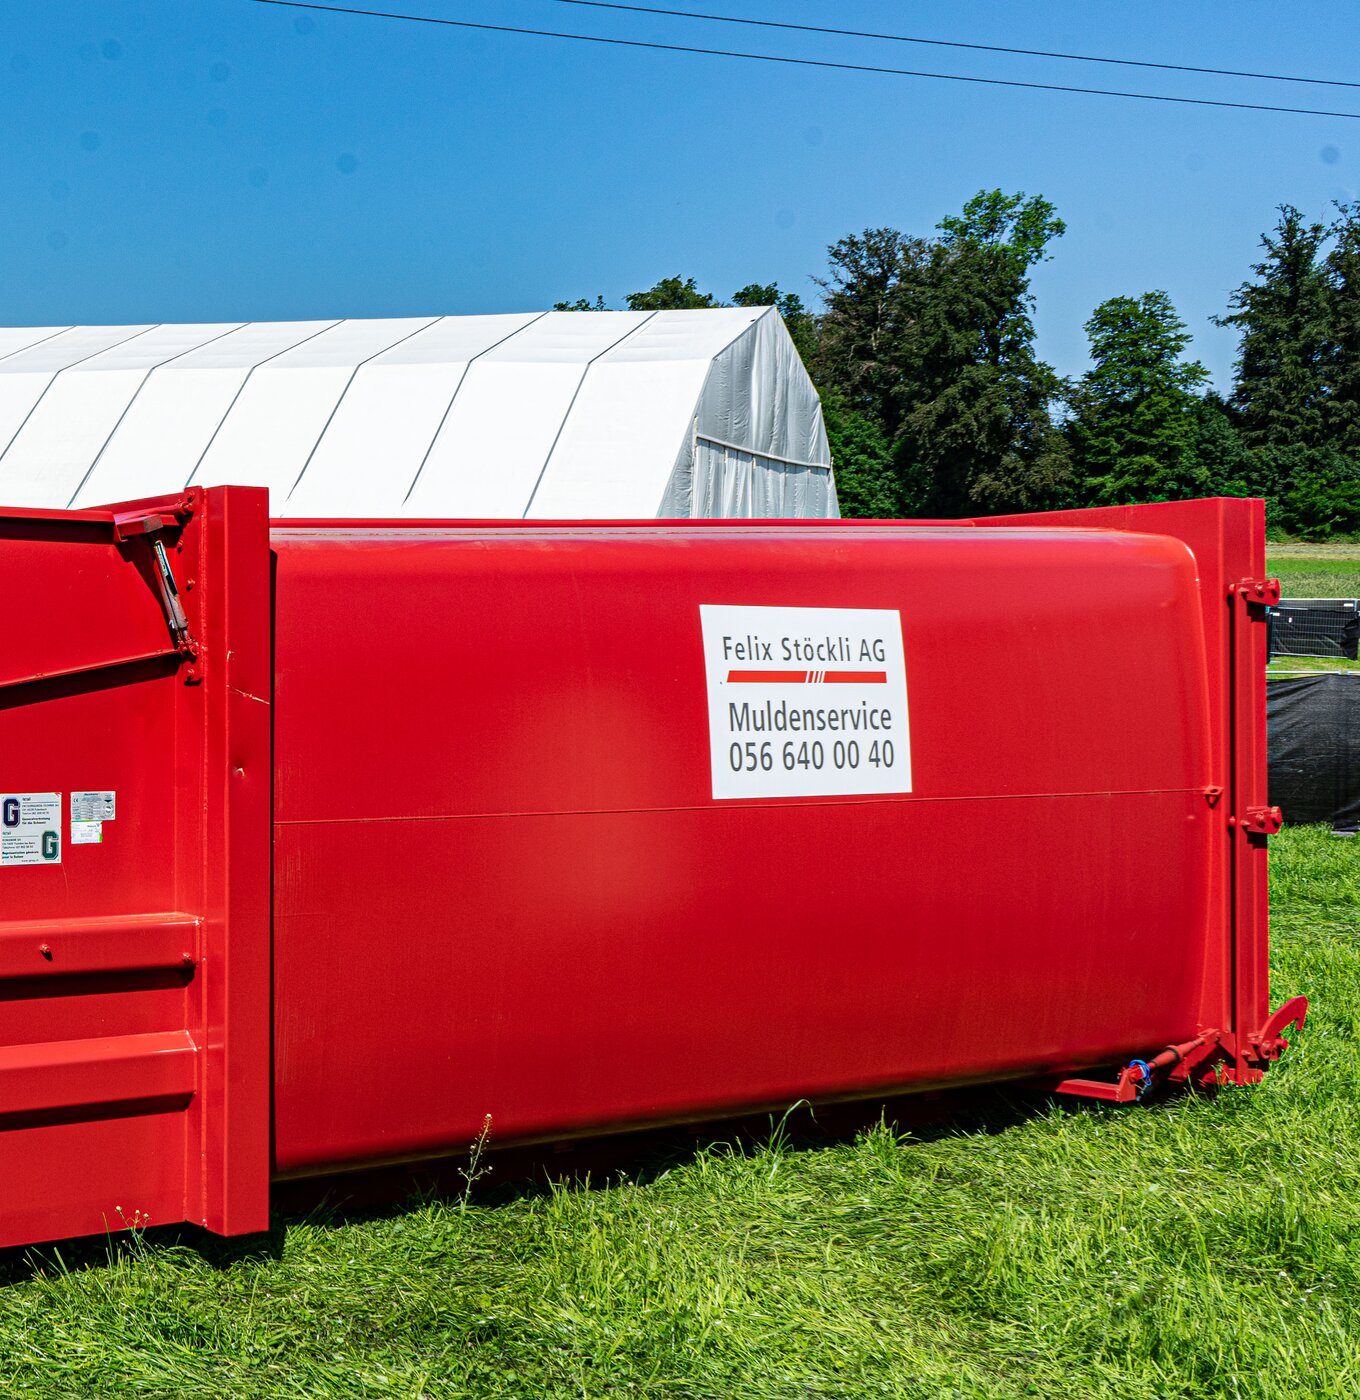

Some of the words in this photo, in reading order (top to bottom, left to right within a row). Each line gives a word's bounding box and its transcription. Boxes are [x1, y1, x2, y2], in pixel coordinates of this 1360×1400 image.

[722, 635, 773, 661] Felix
[781, 636, 851, 662] Stöckli
[859, 638, 886, 662] AG
[729, 700, 892, 732] Muldenservice
[730, 741, 773, 772] 056
[782, 740, 824, 771] 640
[833, 740, 860, 769] 00
[868, 739, 895, 768] 40
[3, 798, 21, 828] G
[42, 831, 59, 860] G
